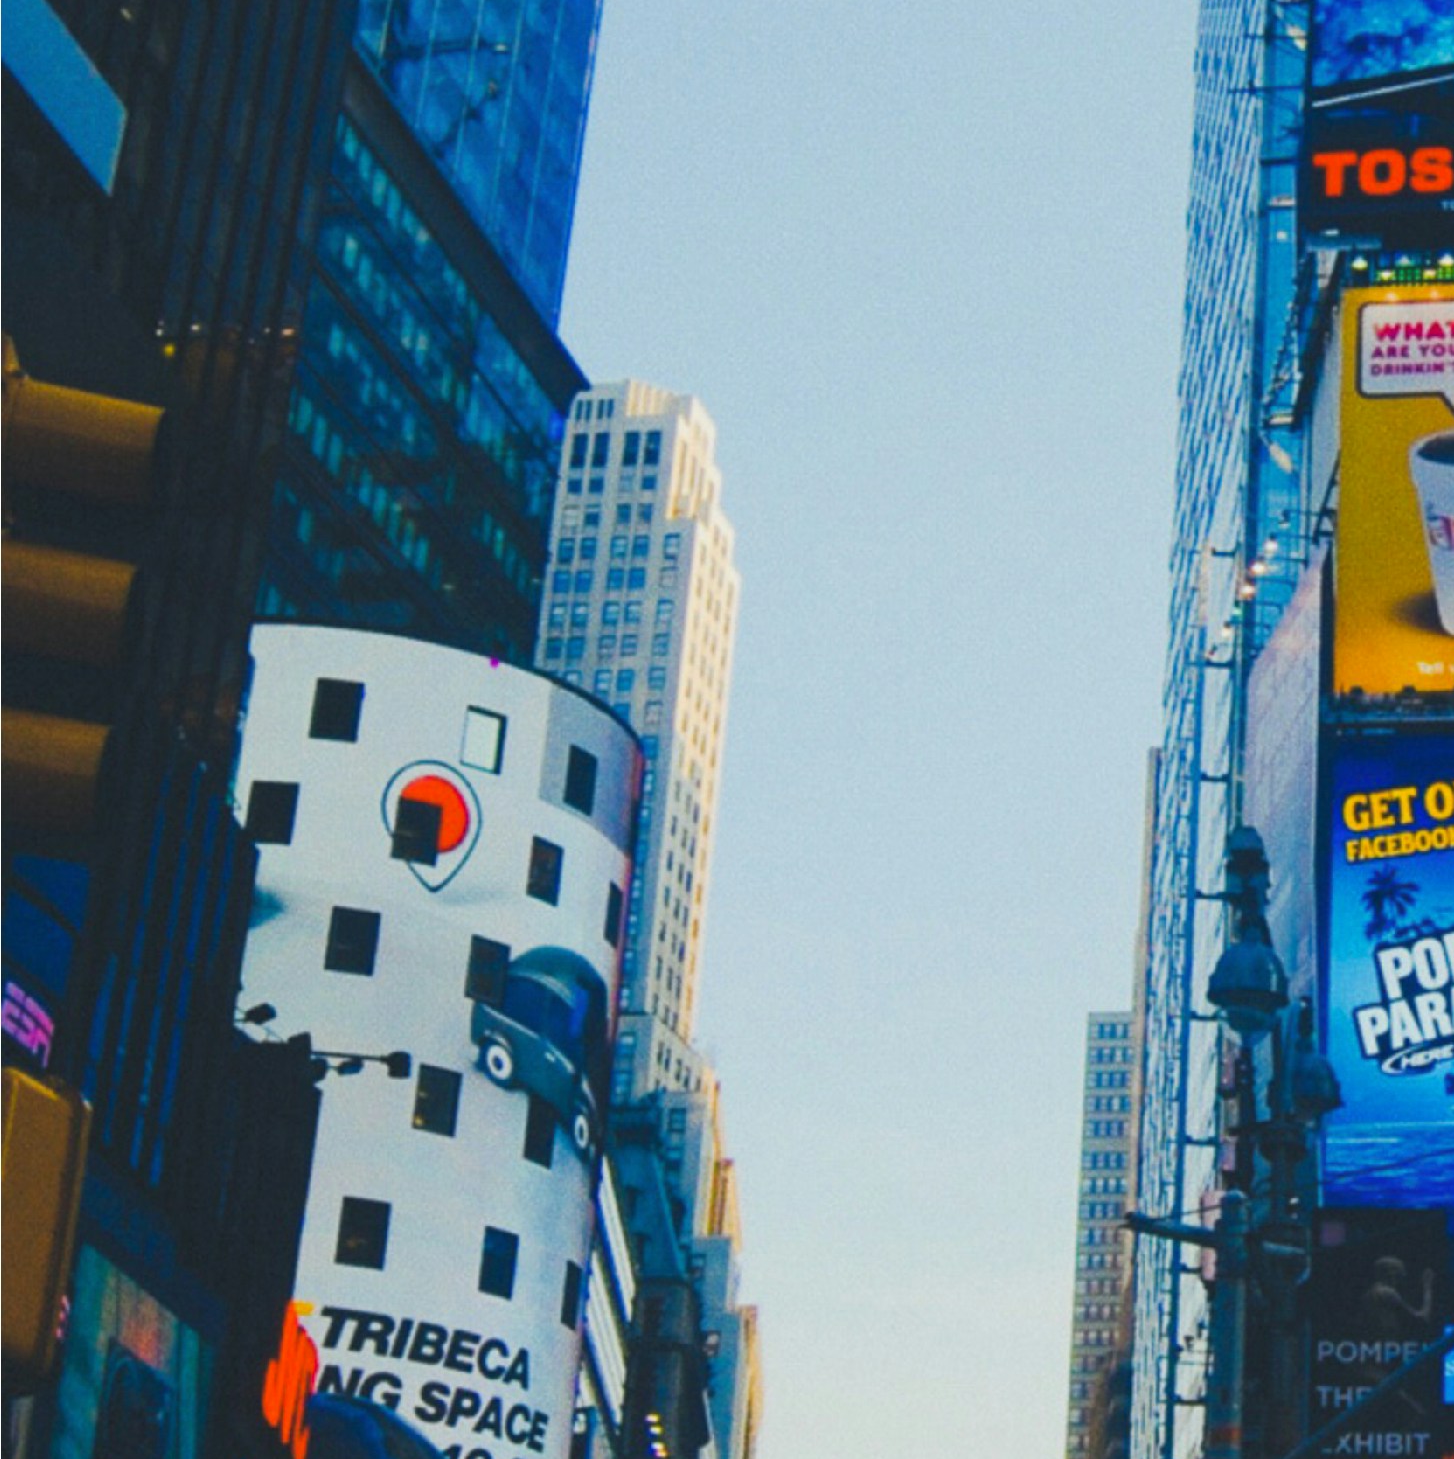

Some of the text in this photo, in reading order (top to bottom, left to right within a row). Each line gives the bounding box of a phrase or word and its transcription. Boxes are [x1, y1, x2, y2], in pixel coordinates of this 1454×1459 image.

[1371, 344, 1410, 359] ARE
[1416, 661, 1444, 674] Tell
[1343, 787, 1417, 831] GET
[321, 1306, 529, 1390] TRIBECA
[414, 1381, 549, 1453] SPACE
